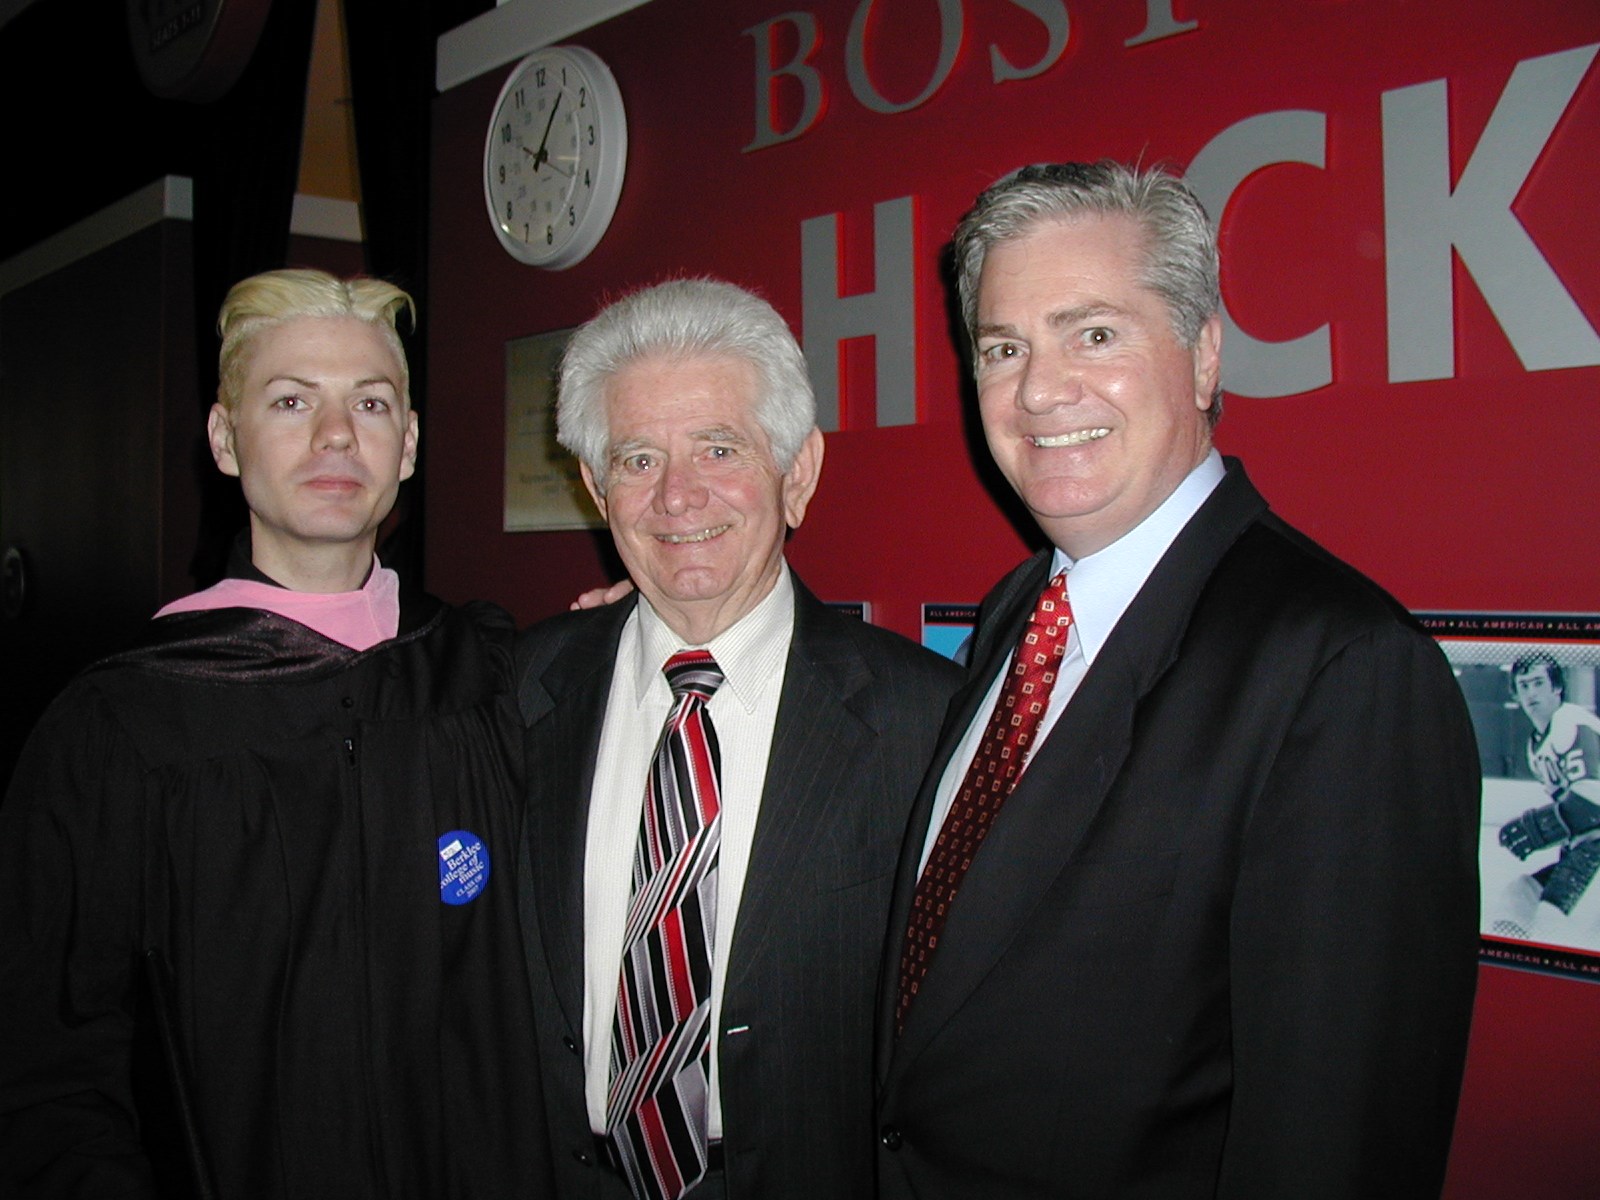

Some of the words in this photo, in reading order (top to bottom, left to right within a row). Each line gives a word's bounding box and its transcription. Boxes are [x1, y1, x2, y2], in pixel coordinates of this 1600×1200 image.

[536, 67, 546, 88] 12
[515, 87, 525, 109] 11
[579, 87, 586, 108] 2
[501, 123, 512, 144] 10
[588, 125, 595, 146] 3
[499, 164, 506, 185] 9
[584, 168, 591, 188] 4
[506, 200, 513, 221] 8
[568, 205, 576, 226] 5
[524, 222, 530, 244] 7
[546, 224, 553, 246] 6
[801, 43, 1600, 433] HCK
[1458, 621, 1479, 629] ALL
[1483, 621, 1544, 630] AMERICAN
[1558, 622, 1579, 630] ALL
[446, 842, 481, 871] Berklee
[468, 853, 479, 867] of
[1479, 948, 1540, 964] AMERICAN
[1554, 960, 1576, 970] ALL
